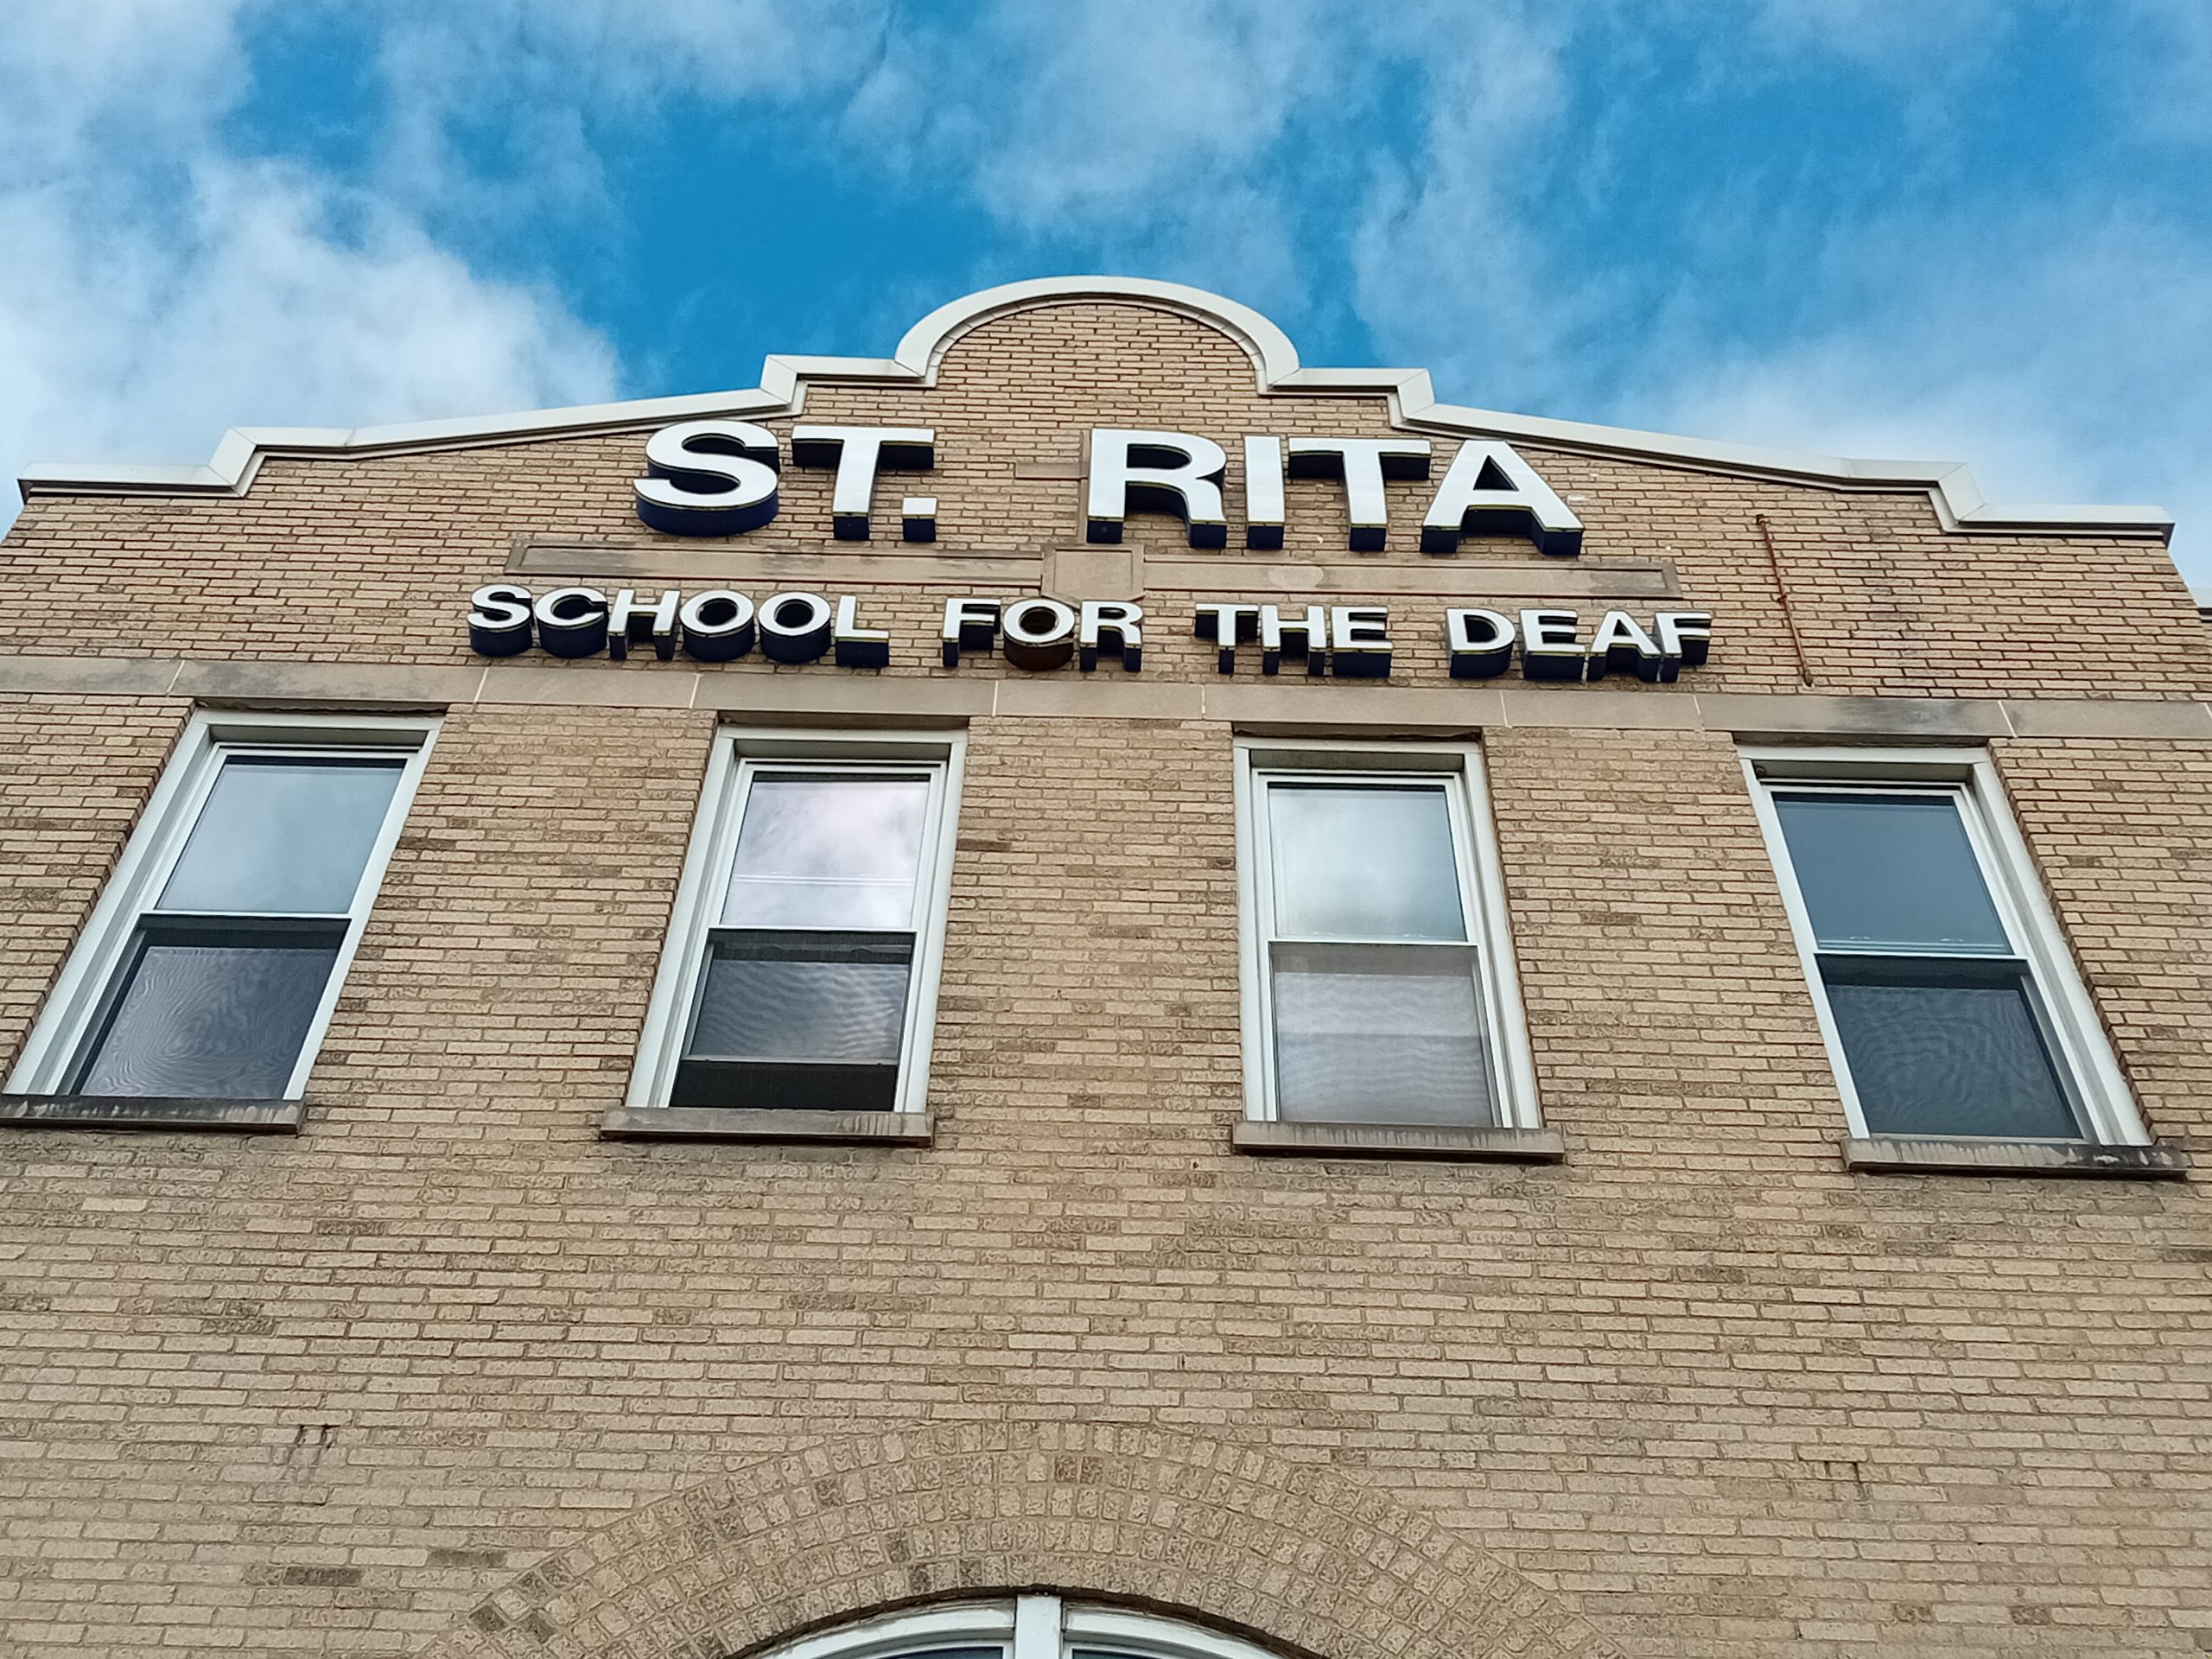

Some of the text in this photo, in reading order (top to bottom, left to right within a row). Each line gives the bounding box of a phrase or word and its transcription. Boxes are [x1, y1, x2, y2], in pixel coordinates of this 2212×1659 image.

[633, 420, 1585, 544] ST. RITA
[469, 584, 1712, 671] SCHOOL FOR THE DEAF
